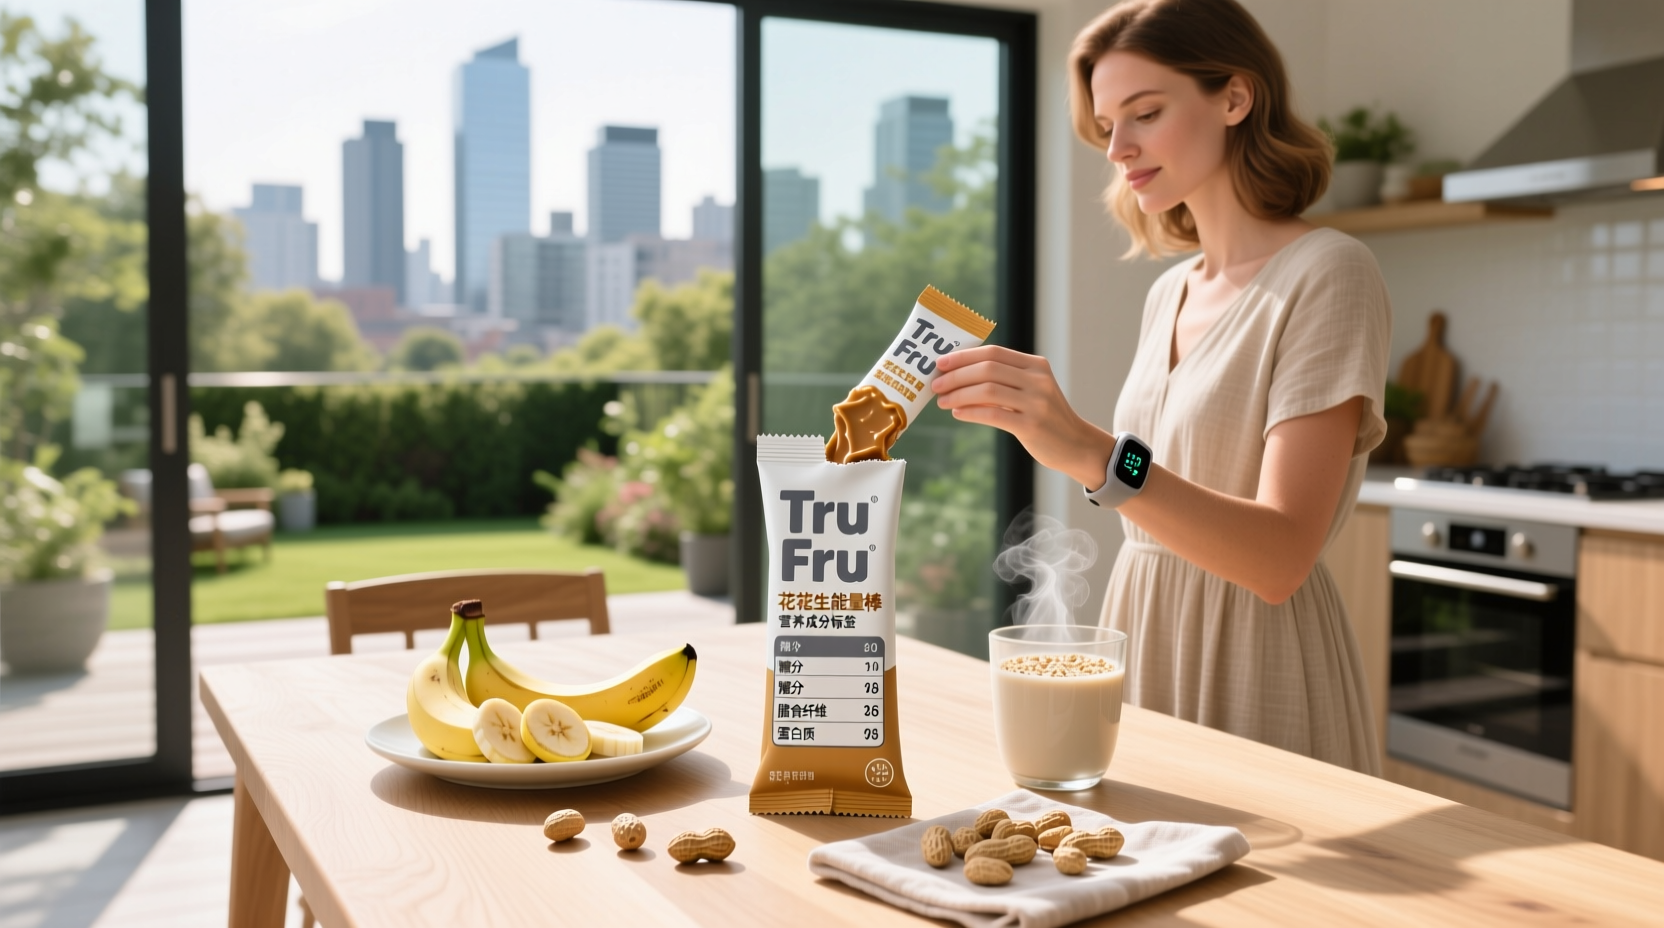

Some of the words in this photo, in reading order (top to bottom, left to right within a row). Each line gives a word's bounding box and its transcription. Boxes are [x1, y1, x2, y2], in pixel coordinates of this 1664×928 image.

[911, 318, 954, 355] Tru
[893, 339, 936, 376] Fru
[780, 490, 869, 535] Tru
[781, 539, 868, 583] Fru
